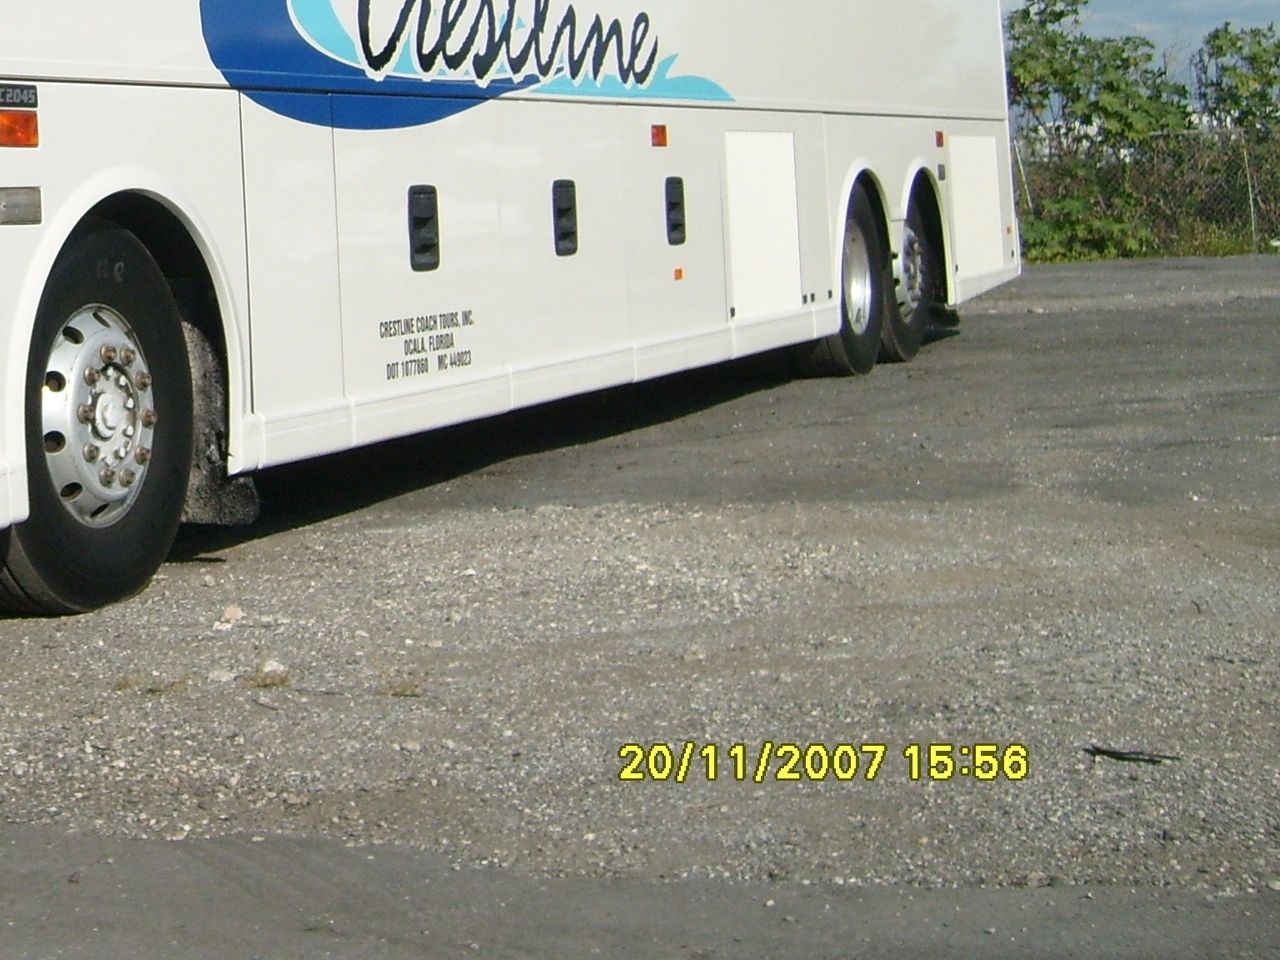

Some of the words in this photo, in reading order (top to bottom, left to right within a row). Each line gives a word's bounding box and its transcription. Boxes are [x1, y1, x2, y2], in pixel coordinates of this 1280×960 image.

[380, 317, 415, 339] CRESTLINE
[416, 313, 437, 333] COACH
[439, 310, 461, 330] TOURS,
[461, 309, 475, 327] INC.
[428, 333, 455, 352] FLORIDA
[386, 362, 399, 381] DOT
[437, 353, 448, 371] MC
